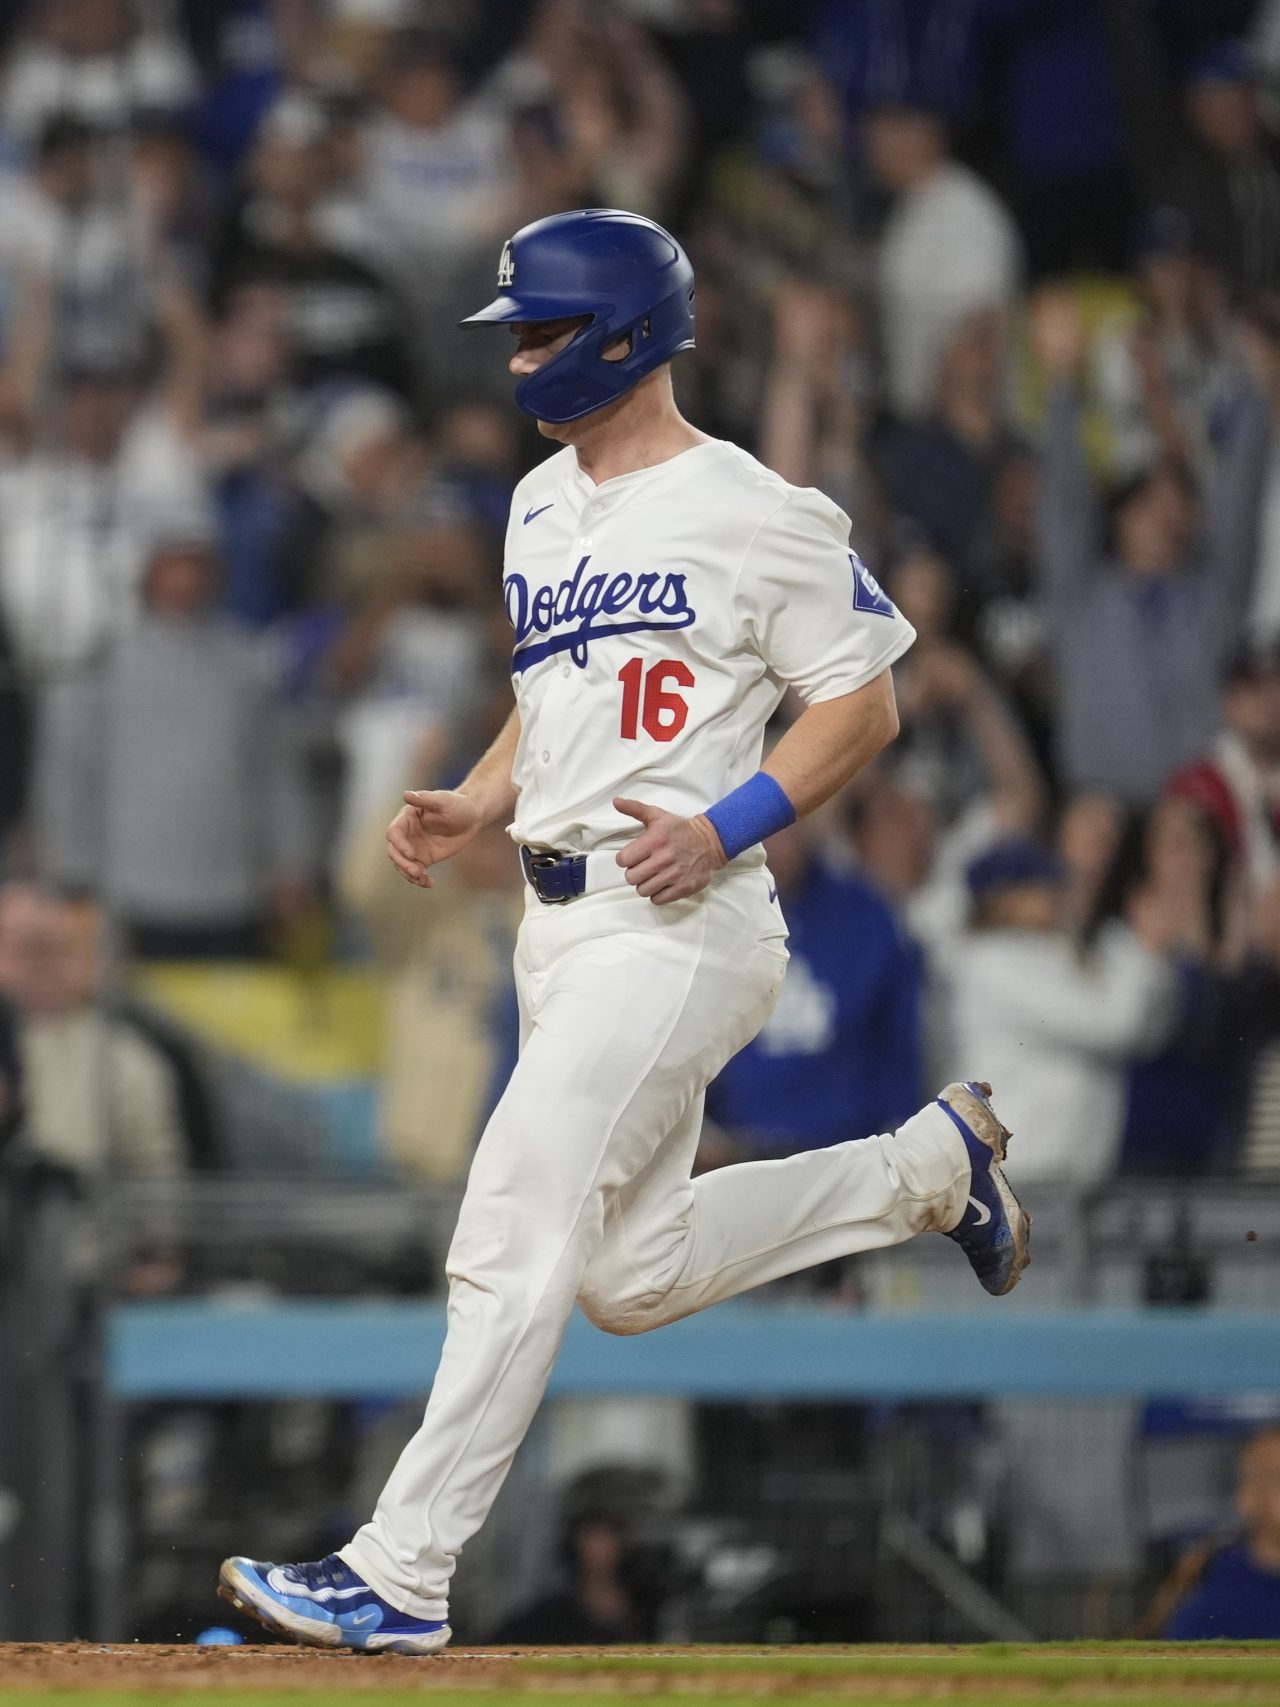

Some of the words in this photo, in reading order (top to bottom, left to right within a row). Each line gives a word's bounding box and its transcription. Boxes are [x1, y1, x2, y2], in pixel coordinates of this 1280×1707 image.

[497, 239, 515, 287] LA
[505, 555, 696, 670] Dodgers
[618, 657, 696, 742] 16
